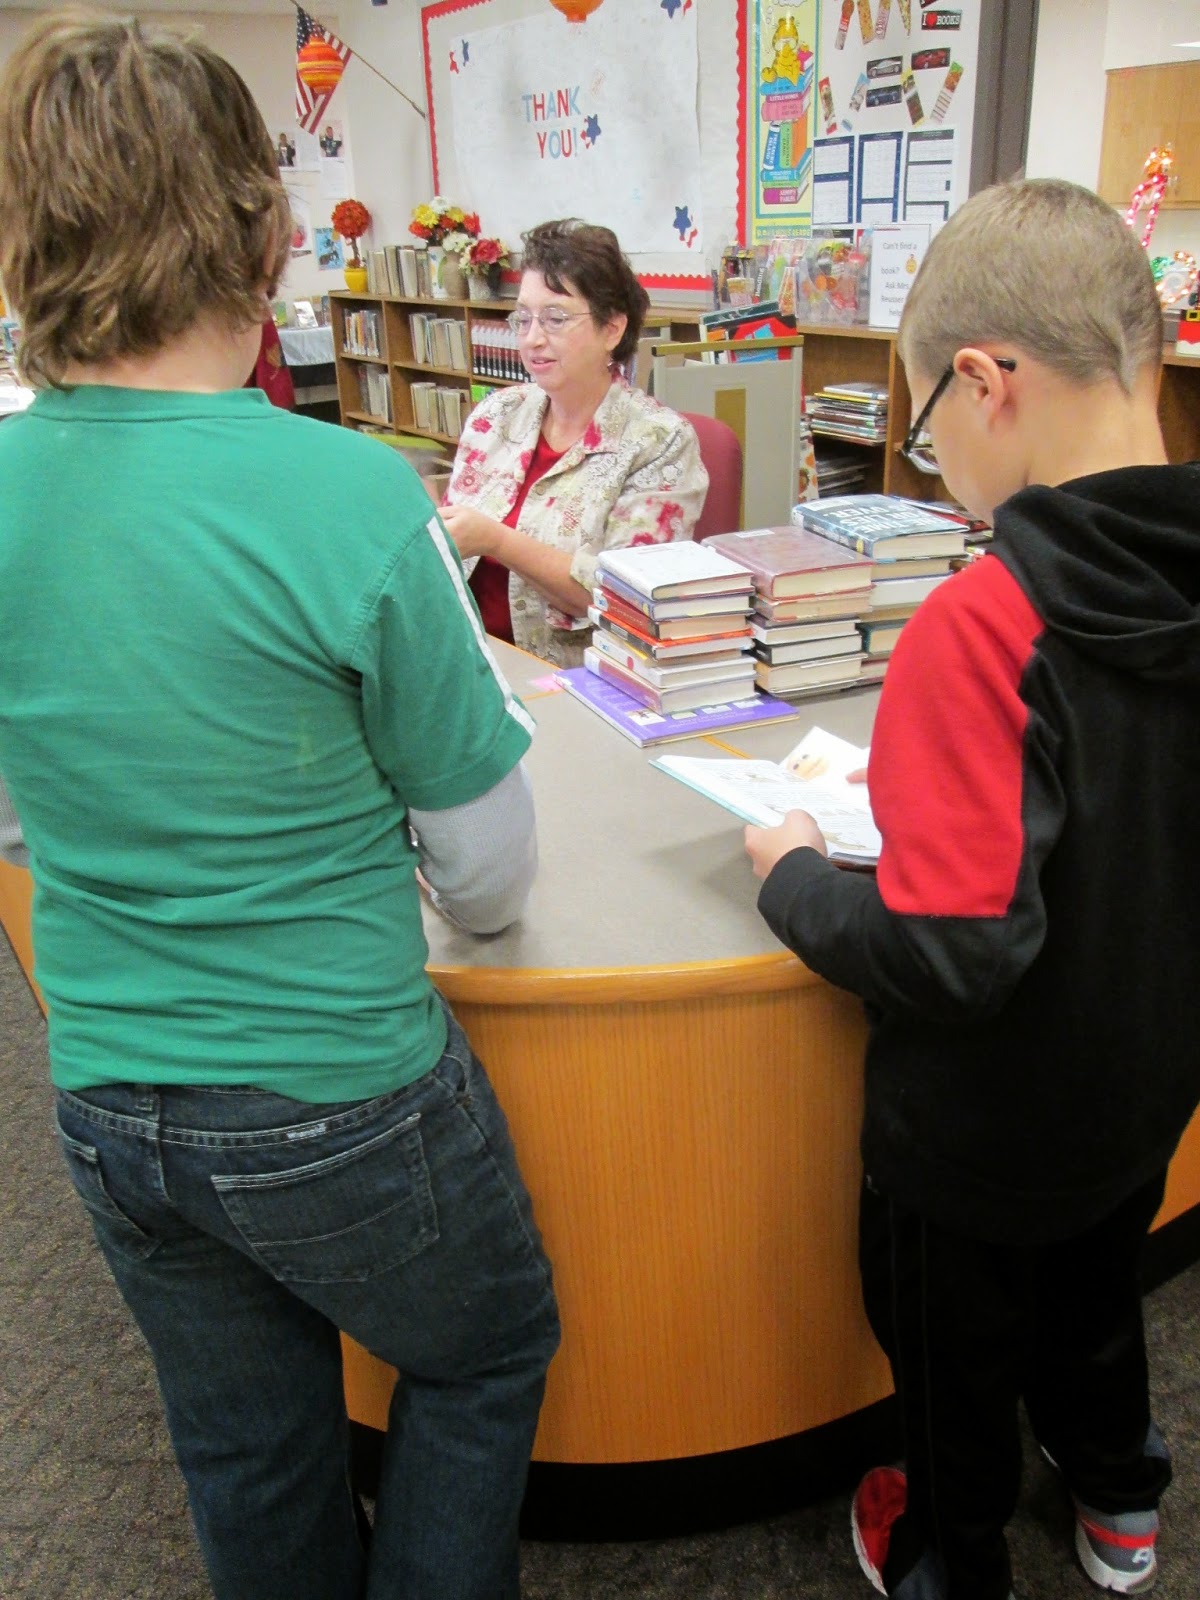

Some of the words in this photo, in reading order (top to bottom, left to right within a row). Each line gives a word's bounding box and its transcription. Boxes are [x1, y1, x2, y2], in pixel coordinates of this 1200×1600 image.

[922, 13, 927, 26] I
[936, 15, 961, 25] BOOKS
[521, 85, 581, 123] THANK
[536, 127, 578, 159] YOU!
[882, 242, 899, 250] Can't
[899, 242, 912, 250] find
[881, 266, 900, 274] book?
[823, 505, 890, 518] OVER.
[840, 514, 888, 526] LIES
